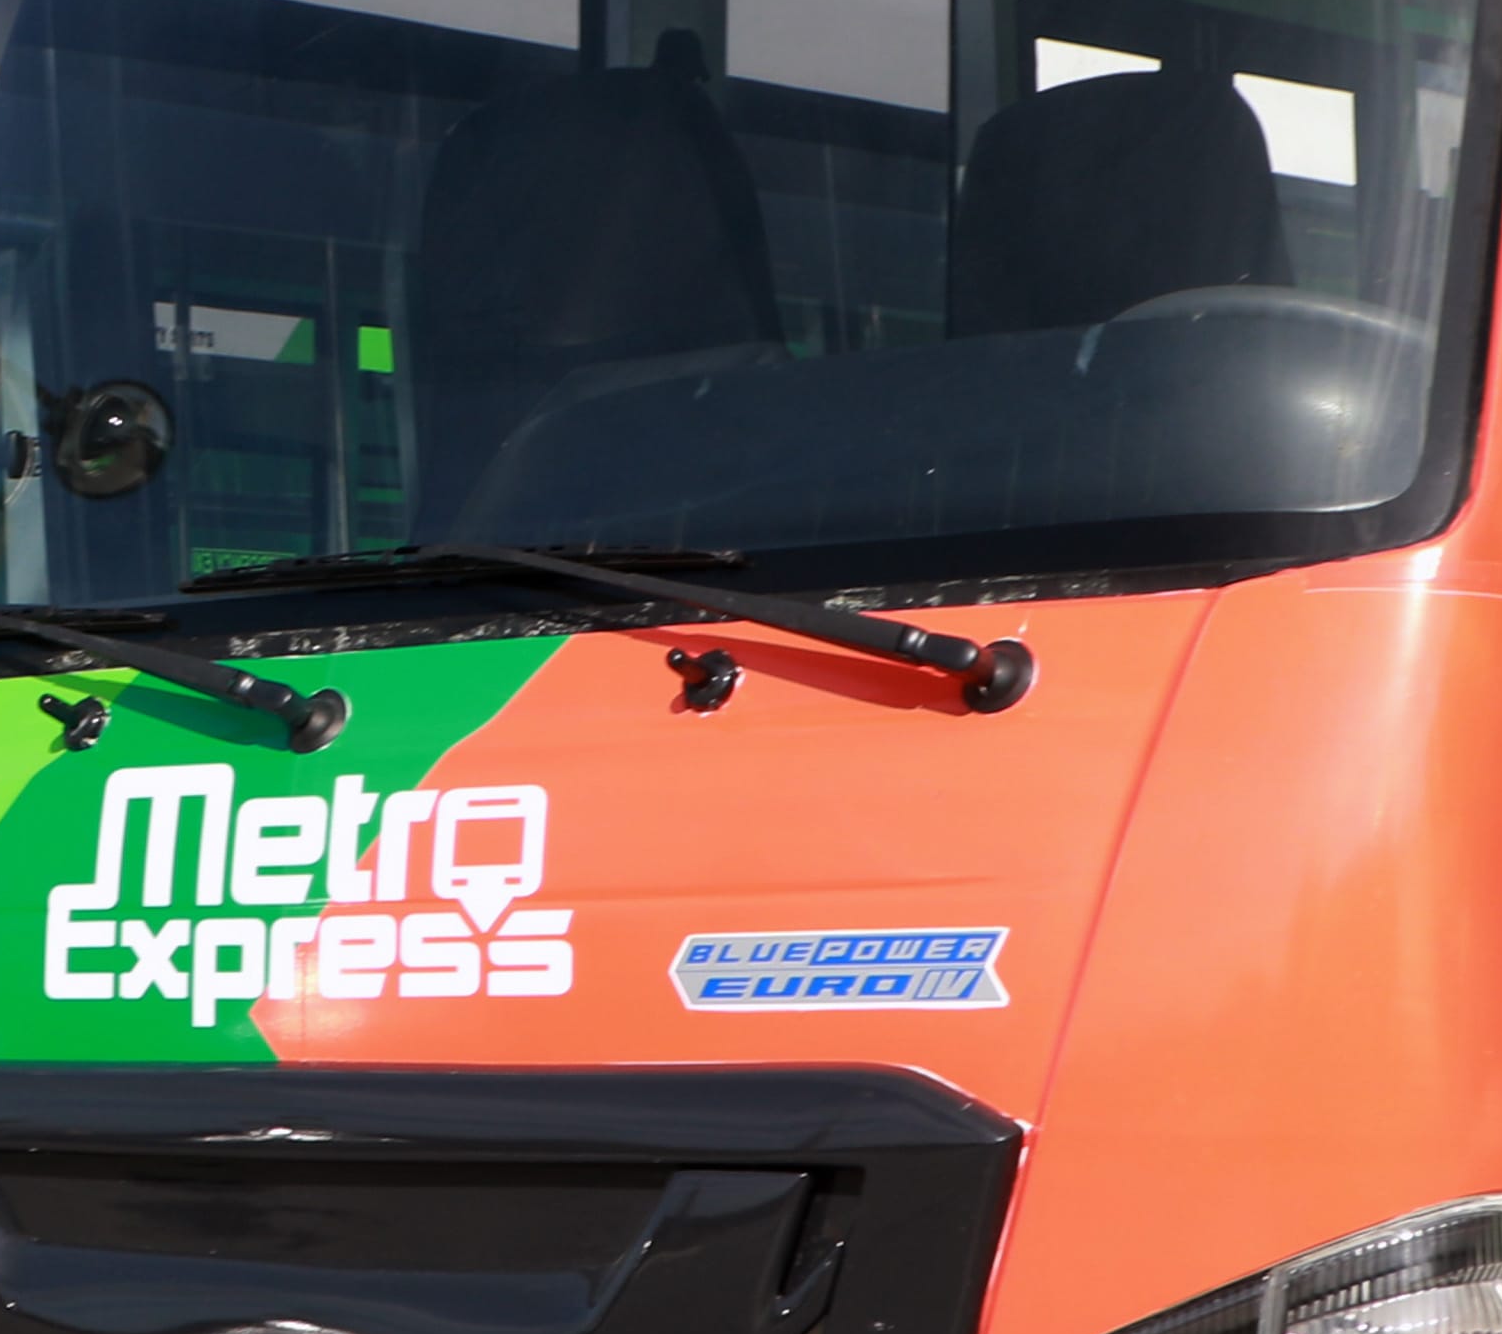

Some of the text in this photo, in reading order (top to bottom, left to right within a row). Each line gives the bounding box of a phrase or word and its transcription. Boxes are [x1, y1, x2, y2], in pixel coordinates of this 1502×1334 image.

[54, 763, 548, 914] Metro
[44, 889, 575, 1027] Express
[699, 968, 982, 1000] EURO IV
